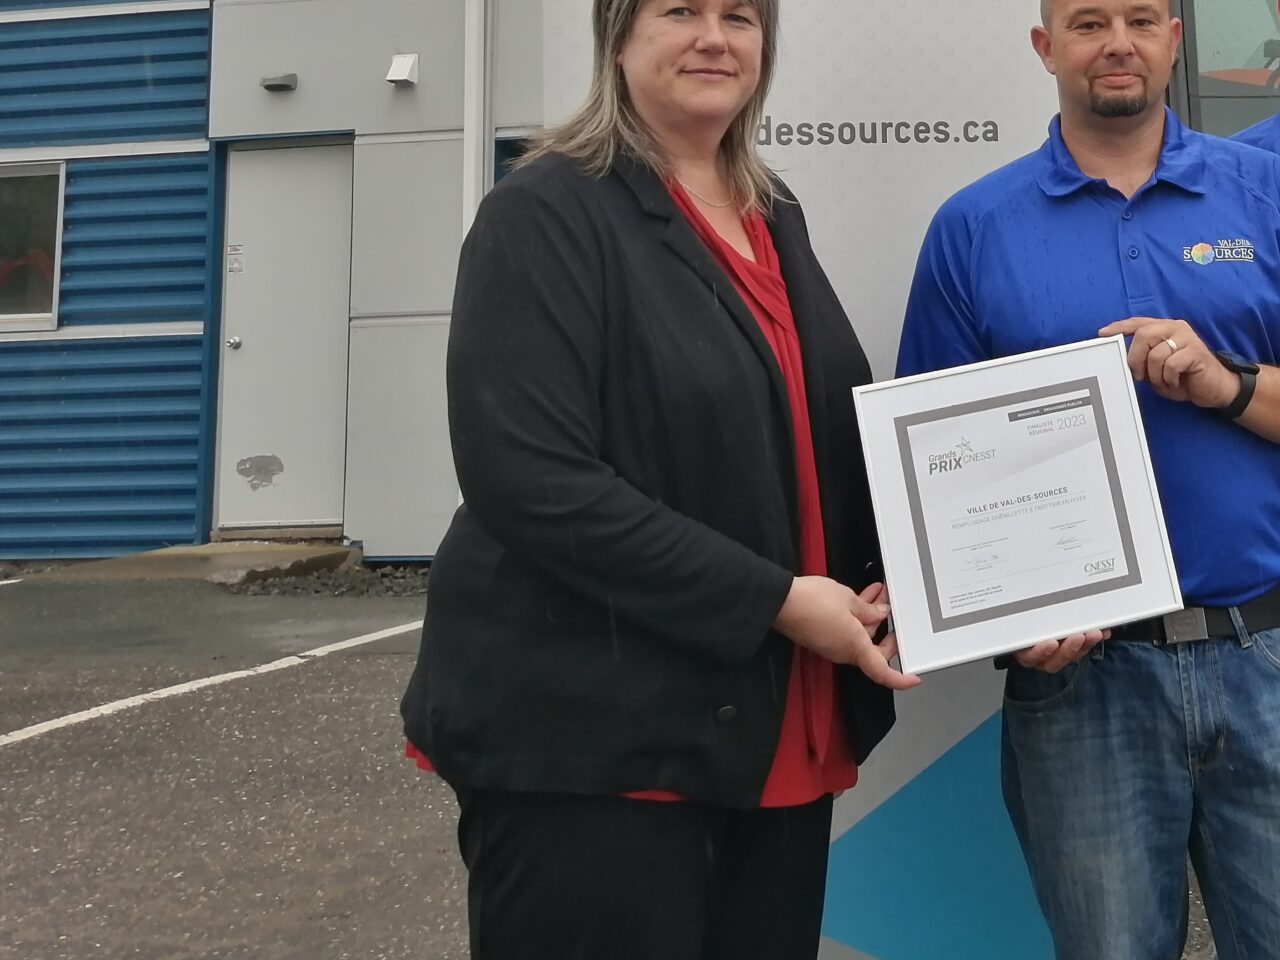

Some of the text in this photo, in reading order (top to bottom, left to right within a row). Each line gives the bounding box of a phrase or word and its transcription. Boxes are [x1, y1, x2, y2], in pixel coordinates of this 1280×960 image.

[757, 115, 1000, 146] dessources.ca
[1056, 413, 1087, 431] 2023
[928, 450, 957, 462] Grands
[929, 448, 997, 476] PRIX CNESST
[966, 486, 1069, 515] VILLE DE VAL-DES-SOURCES
